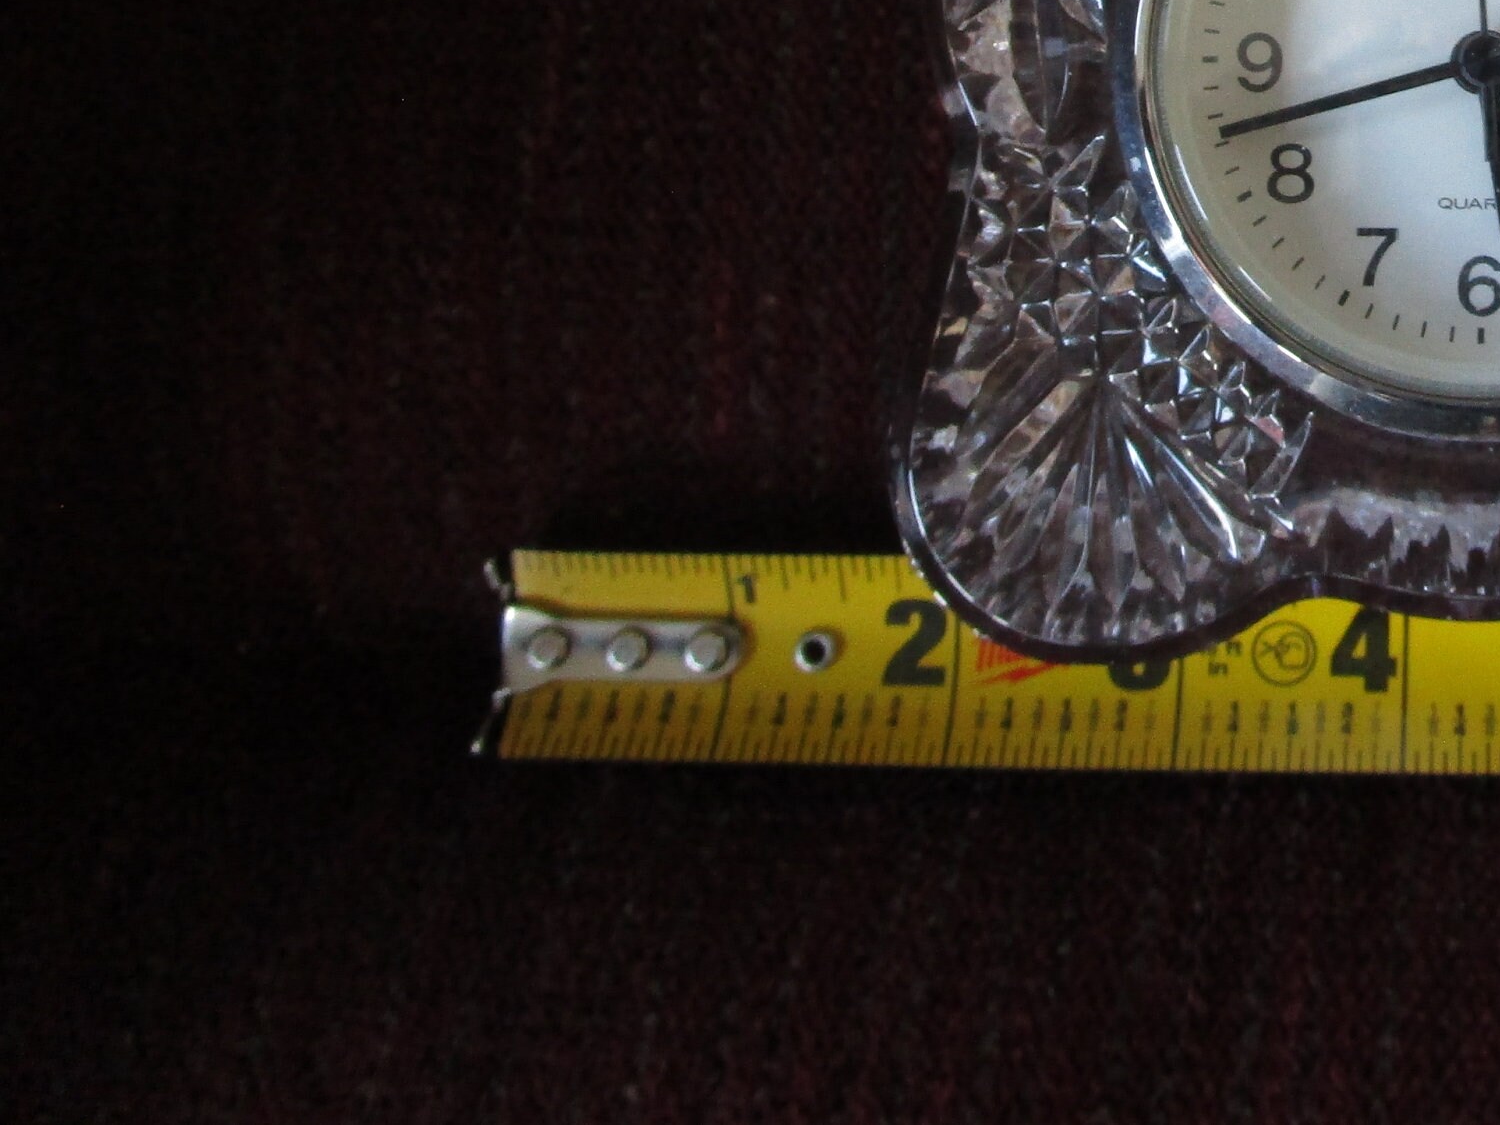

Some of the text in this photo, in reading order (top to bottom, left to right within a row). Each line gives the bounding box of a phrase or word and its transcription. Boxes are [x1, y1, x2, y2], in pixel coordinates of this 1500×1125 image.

[1237, 32, 1284, 93] 9
[1267, 142, 1316, 205] 8
[1356, 227, 1399, 288] 7
[880, 598, 947, 687] 2
[1330, 606, 1398, 692] 4
